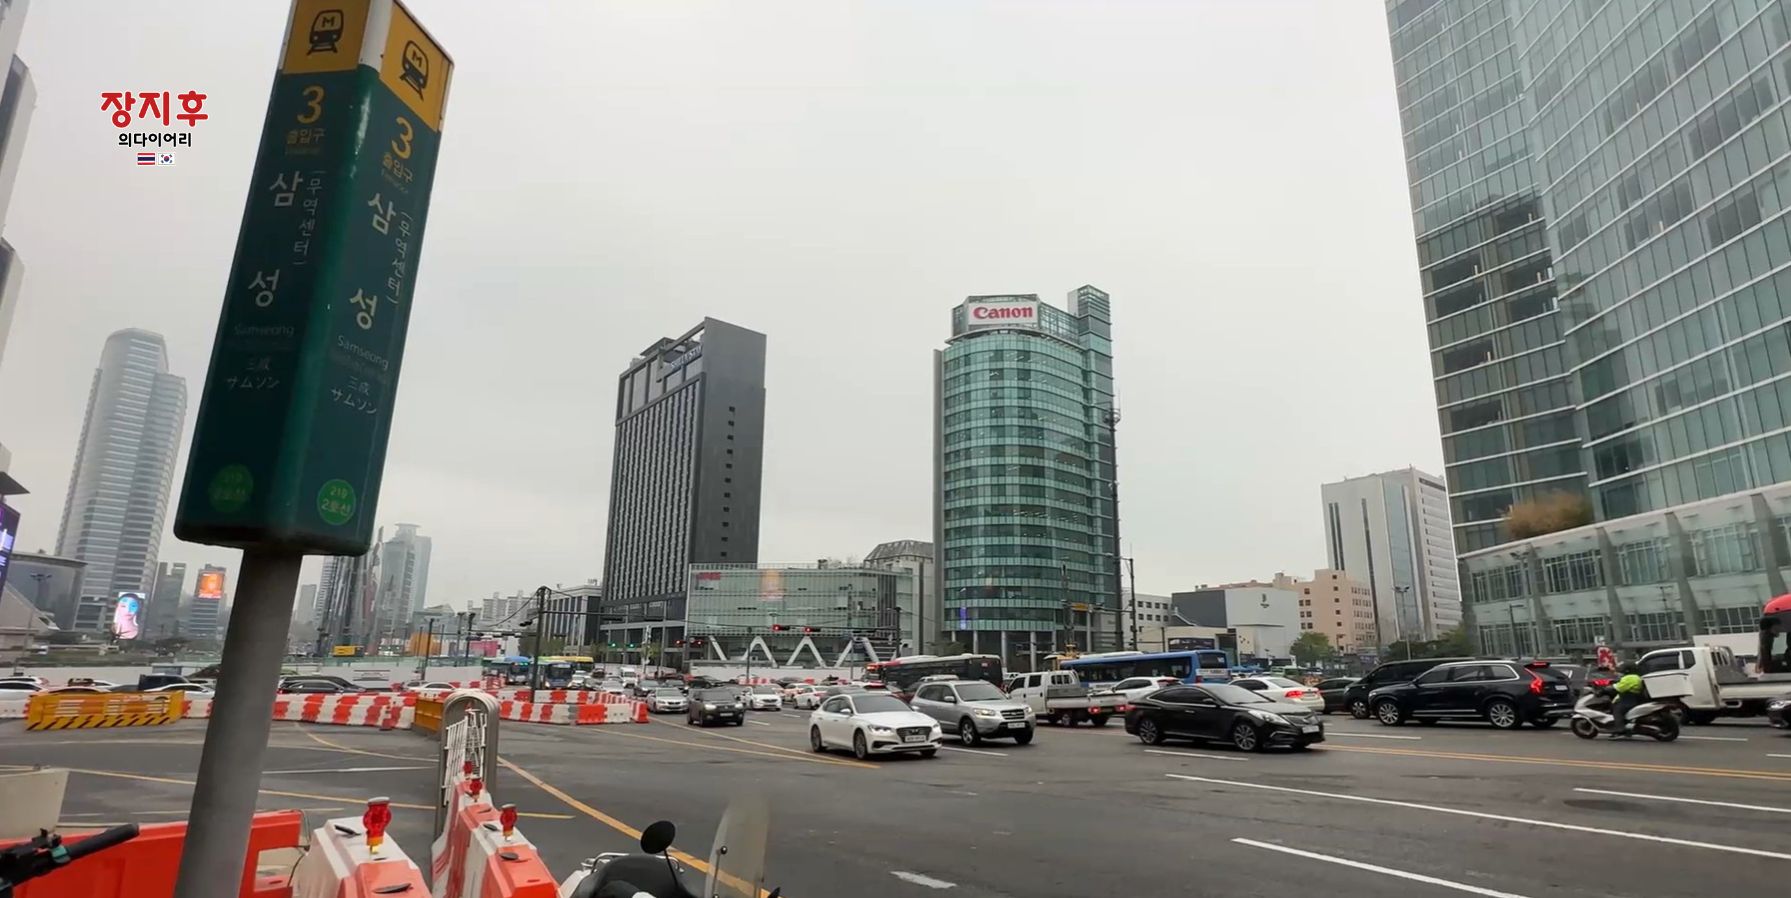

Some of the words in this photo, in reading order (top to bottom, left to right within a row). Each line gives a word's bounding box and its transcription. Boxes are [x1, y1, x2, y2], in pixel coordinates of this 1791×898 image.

[297, 85, 325, 124] 3
[392, 116, 414, 160] 3
[973, 306, 1033, 320] Canon
[337, 335, 390, 371] Samseong
